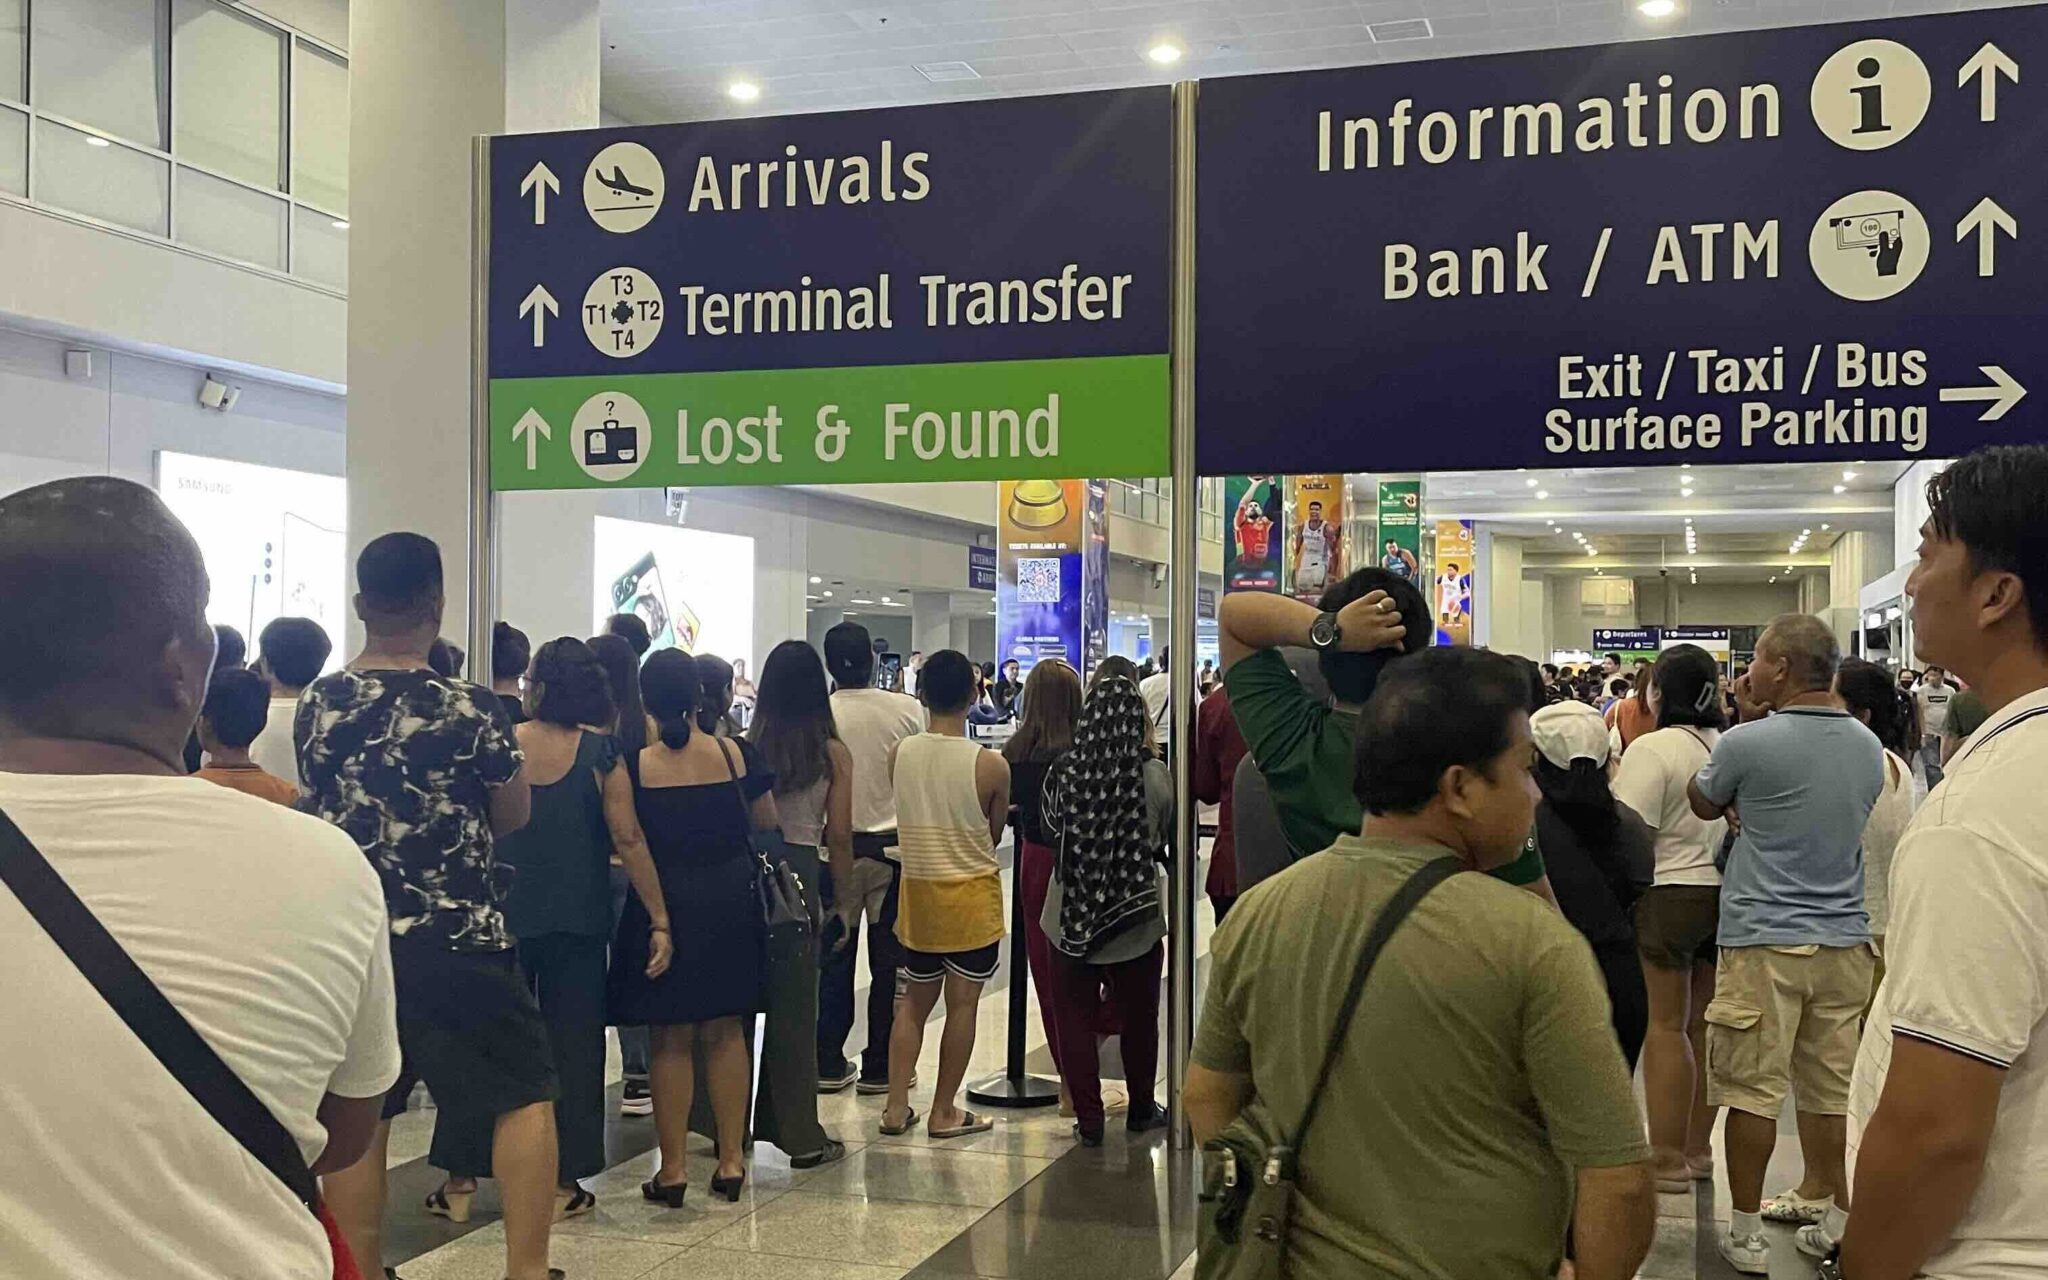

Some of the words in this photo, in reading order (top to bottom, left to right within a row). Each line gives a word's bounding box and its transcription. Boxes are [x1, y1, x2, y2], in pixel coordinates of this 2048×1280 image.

[1318, 73, 1780, 173] Information
[688, 140, 931, 212] Arrivals
[610, 274, 635, 296] T3
[1383, 231, 1550, 301] Bank
[1581, 227, 1614, 298] /
[1646, 219, 1780, 285] ATM
[584, 303, 607, 325] T1
[636, 300, 661, 322] T2
[679, 273, 894, 337] Terminal
[918, 263, 1133, 328] Transfer
[611, 329, 635, 350] T4
[1558, 353, 1643, 399] Exit
[1656, 351, 1677, 401] /
[1688, 344, 1784, 395] Taxi
[1800, 344, 1822, 395] /
[1836, 342, 1928, 388] Bus
[676, 405, 784, 465] Lost
[814, 403, 852, 463] &
[884, 392, 1060, 460] Found
[1545, 406, 1722, 453] Surface
[1736, 399, 1928, 452] Parking
